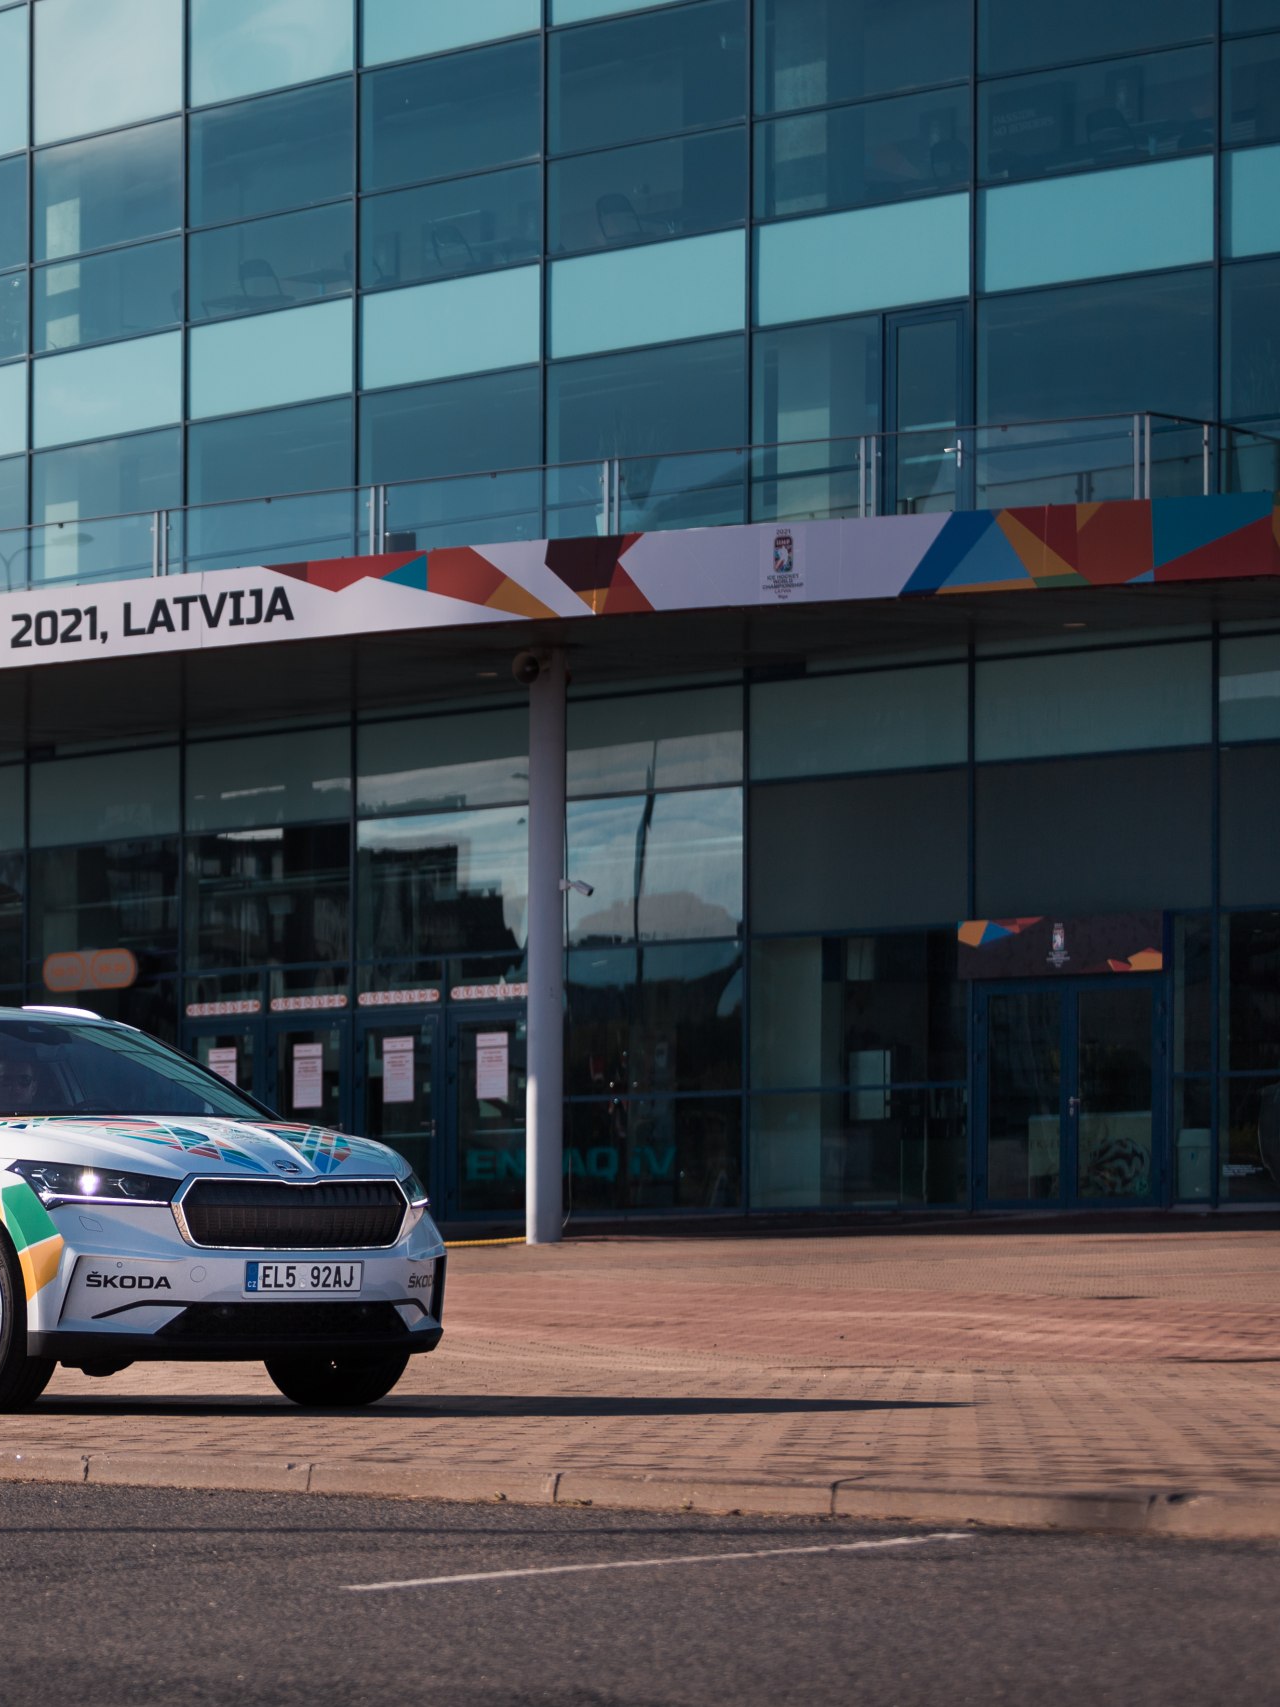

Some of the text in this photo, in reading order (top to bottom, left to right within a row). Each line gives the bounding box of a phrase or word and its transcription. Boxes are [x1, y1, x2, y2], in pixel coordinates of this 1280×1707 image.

[10, 605, 108, 649] 2021,
[123, 585, 295, 637] LATVIJA
[467, 1147, 619, 1182] ENAQ
[85, 1270, 172, 1289] ŠKODA
[247, 1280, 257, 1288] CZ
[261, 1265, 354, 1288] EL5 92AJ
[407, 1273, 433, 1289] ŠKOD
